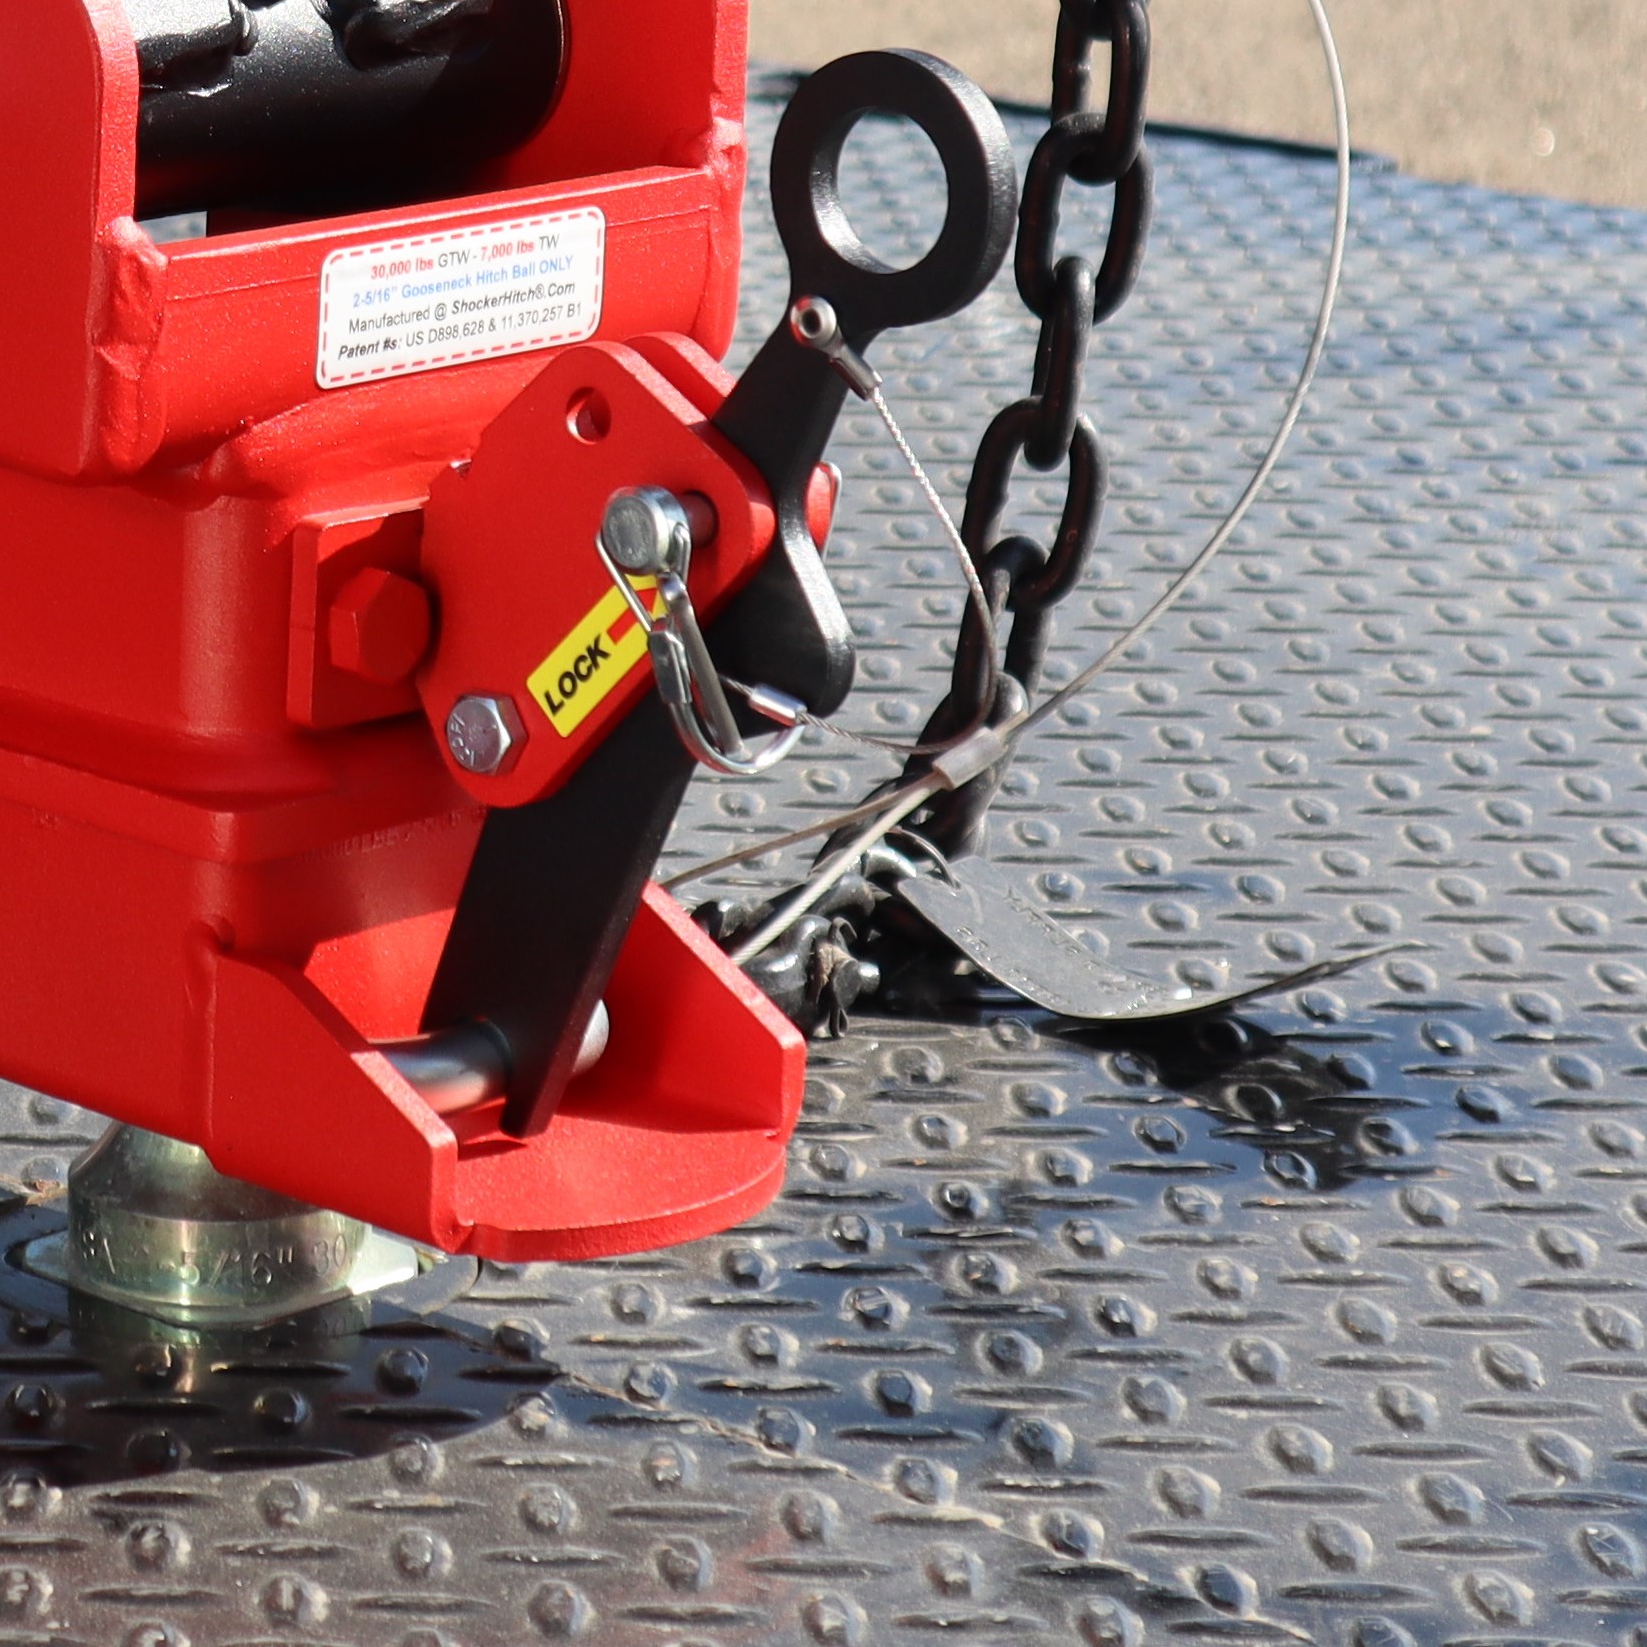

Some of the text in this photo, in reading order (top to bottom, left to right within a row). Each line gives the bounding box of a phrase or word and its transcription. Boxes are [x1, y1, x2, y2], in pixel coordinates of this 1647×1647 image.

[371, 260, 412, 280] 30,000
[415, 257, 434, 272] lbs
[438, 249, 471, 268] GTW
[481, 242, 513, 262] 7,000
[516, 240, 535, 254] lbs
[539, 234, 560, 249] TW
[402, 273, 472, 299] Gooseneck
[476, 267, 508, 285] Hitch
[512, 262, 535, 279] Ball
[539, 255, 573, 274] ONLY
[338, 303, 581, 360] Patent #s: US D898,628 & 11,370,257 B1
[349, 305, 430, 334] Manufactured
[434, 303, 447, 321] @
[544, 634, 611, 716] LOCK
